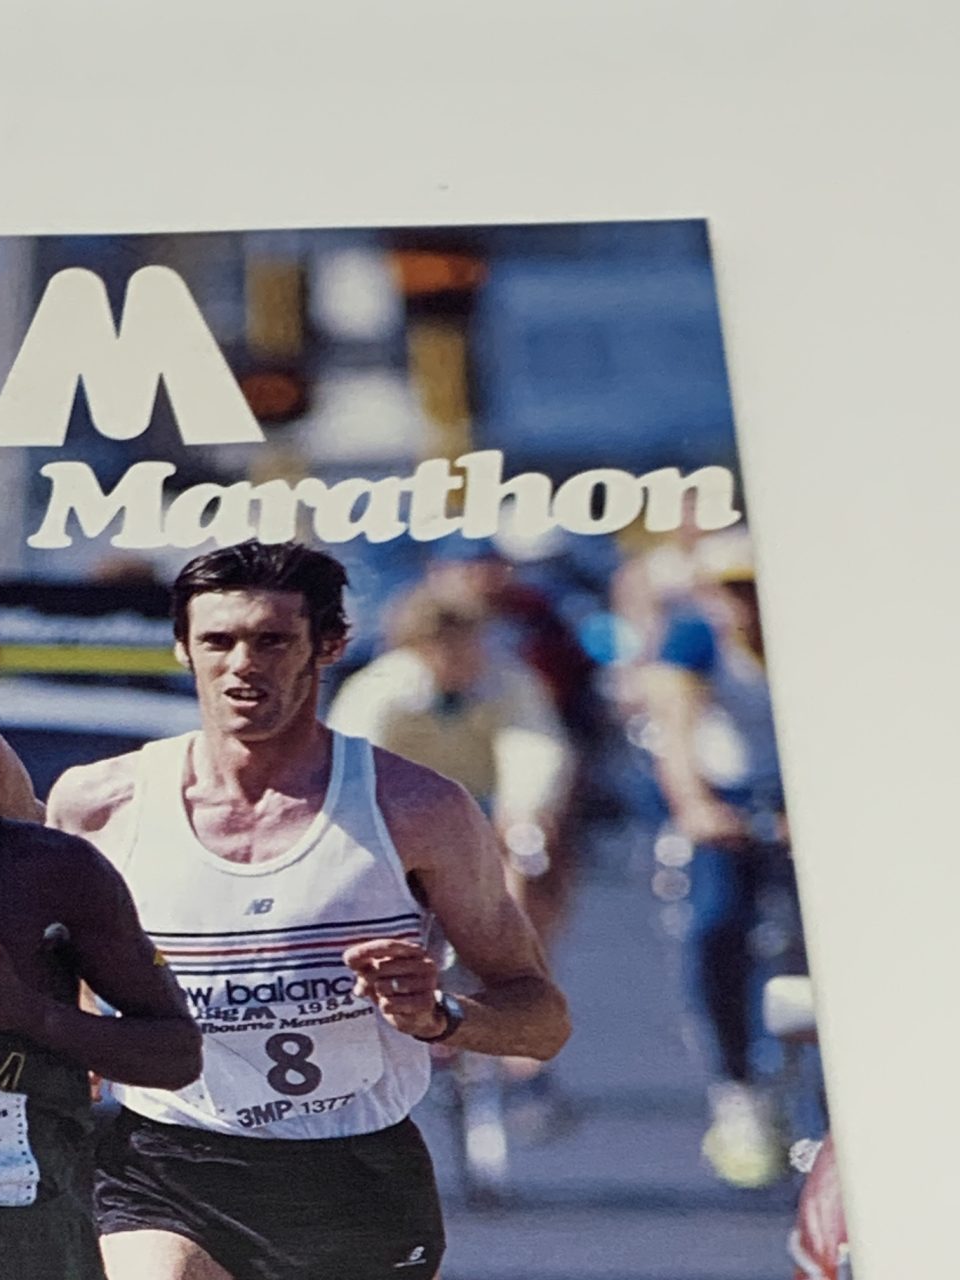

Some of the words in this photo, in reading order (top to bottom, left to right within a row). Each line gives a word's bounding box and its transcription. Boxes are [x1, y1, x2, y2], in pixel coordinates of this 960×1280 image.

[28, 449, 743, 549] Marathon
[225, 975, 357, 1006] balanc
[297, 996, 355, 1016] 1984
[265, 1032, 322, 1096] 8
[236, 1100, 295, 1128] 3MP
[302, 1093, 357, 1115] 1377
